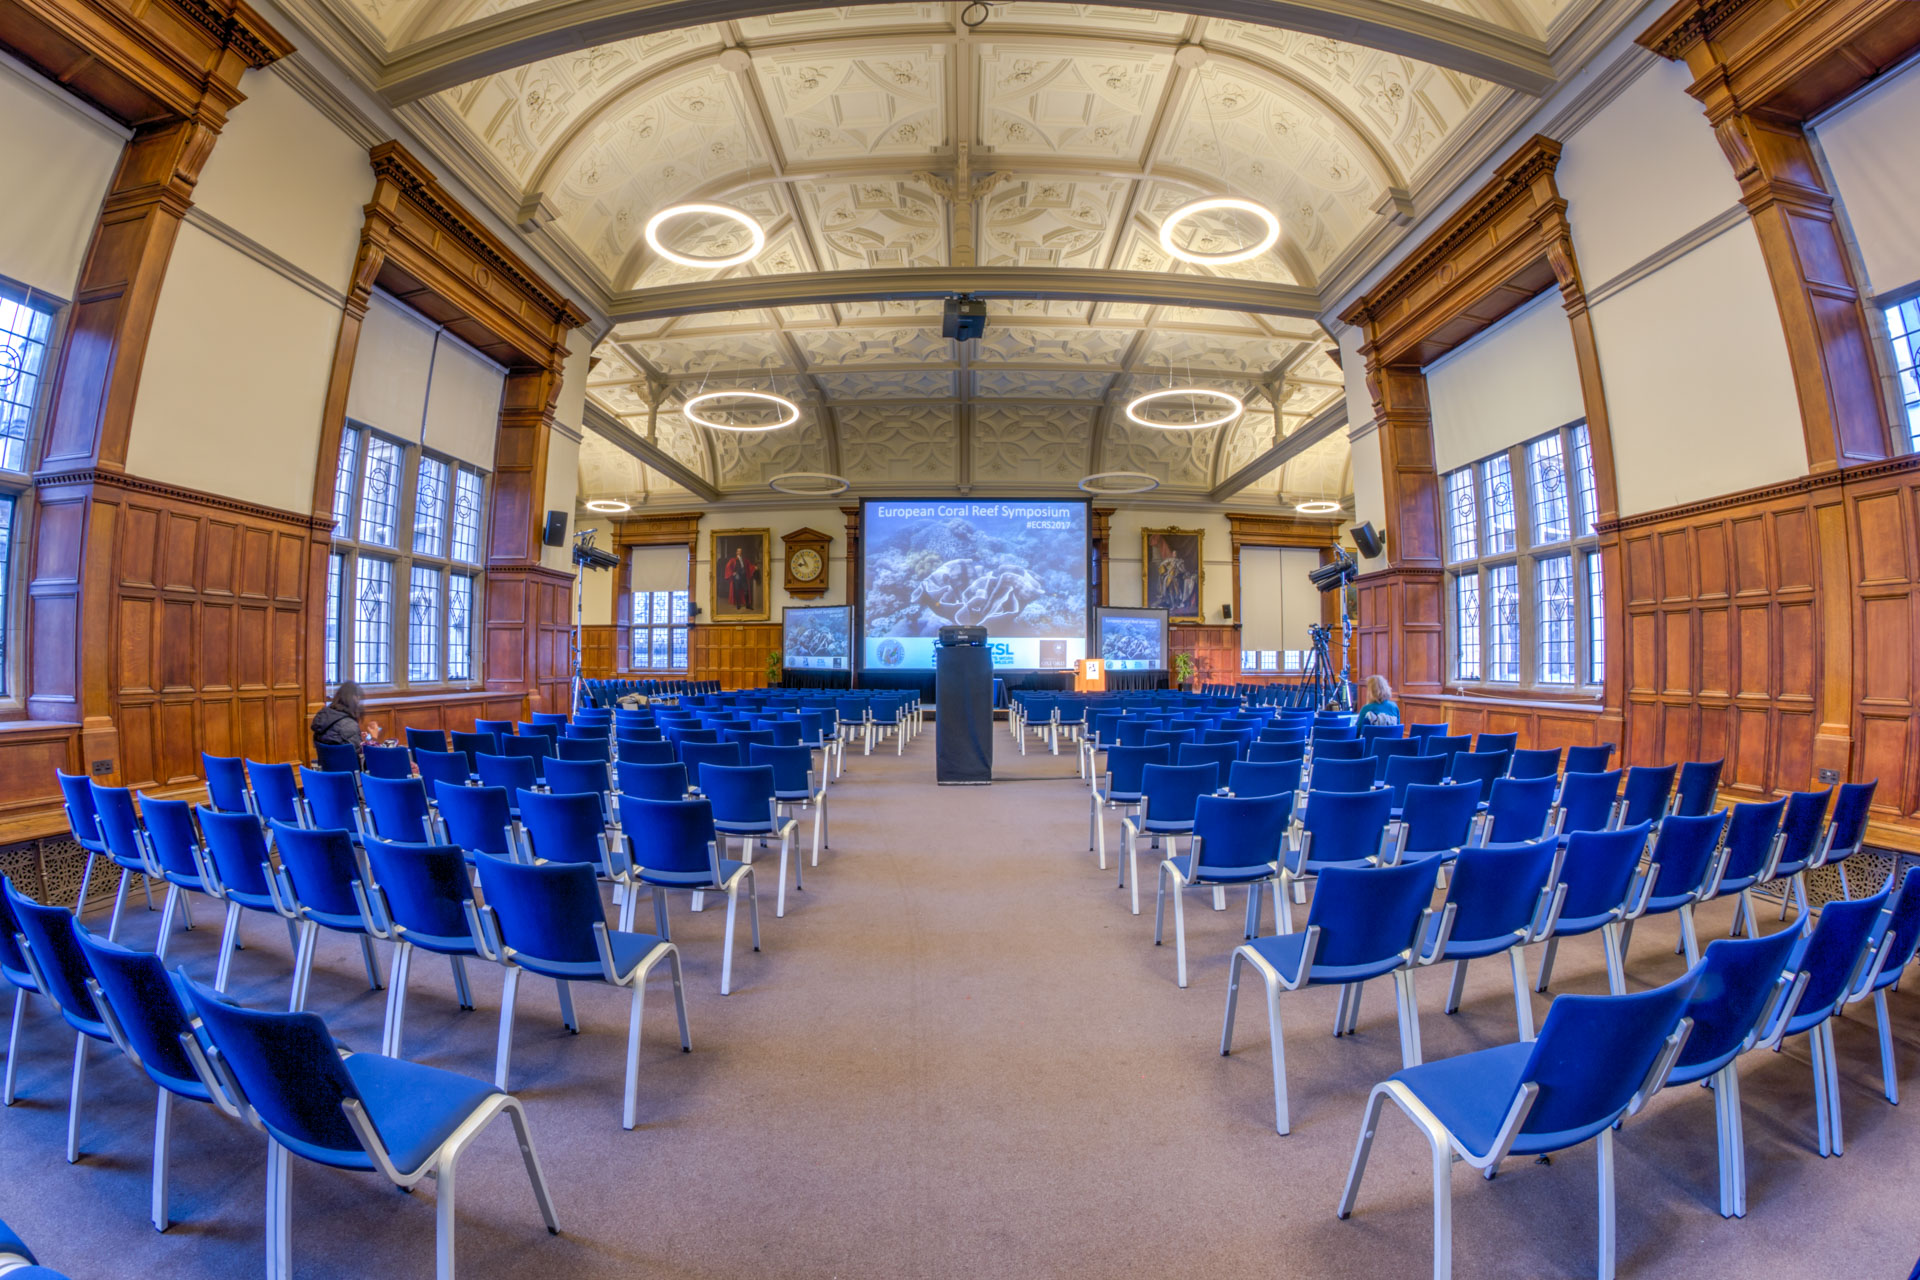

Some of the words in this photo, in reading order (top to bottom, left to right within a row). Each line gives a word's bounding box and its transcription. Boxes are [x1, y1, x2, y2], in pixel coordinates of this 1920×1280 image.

[878, 506, 935, 520] European
[937, 505, 969, 517] Coral
[972, 505, 999, 517] Reef
[1001, 505, 1070, 519] Symposium
[1026, 520, 1071, 530] #ECRS2017
